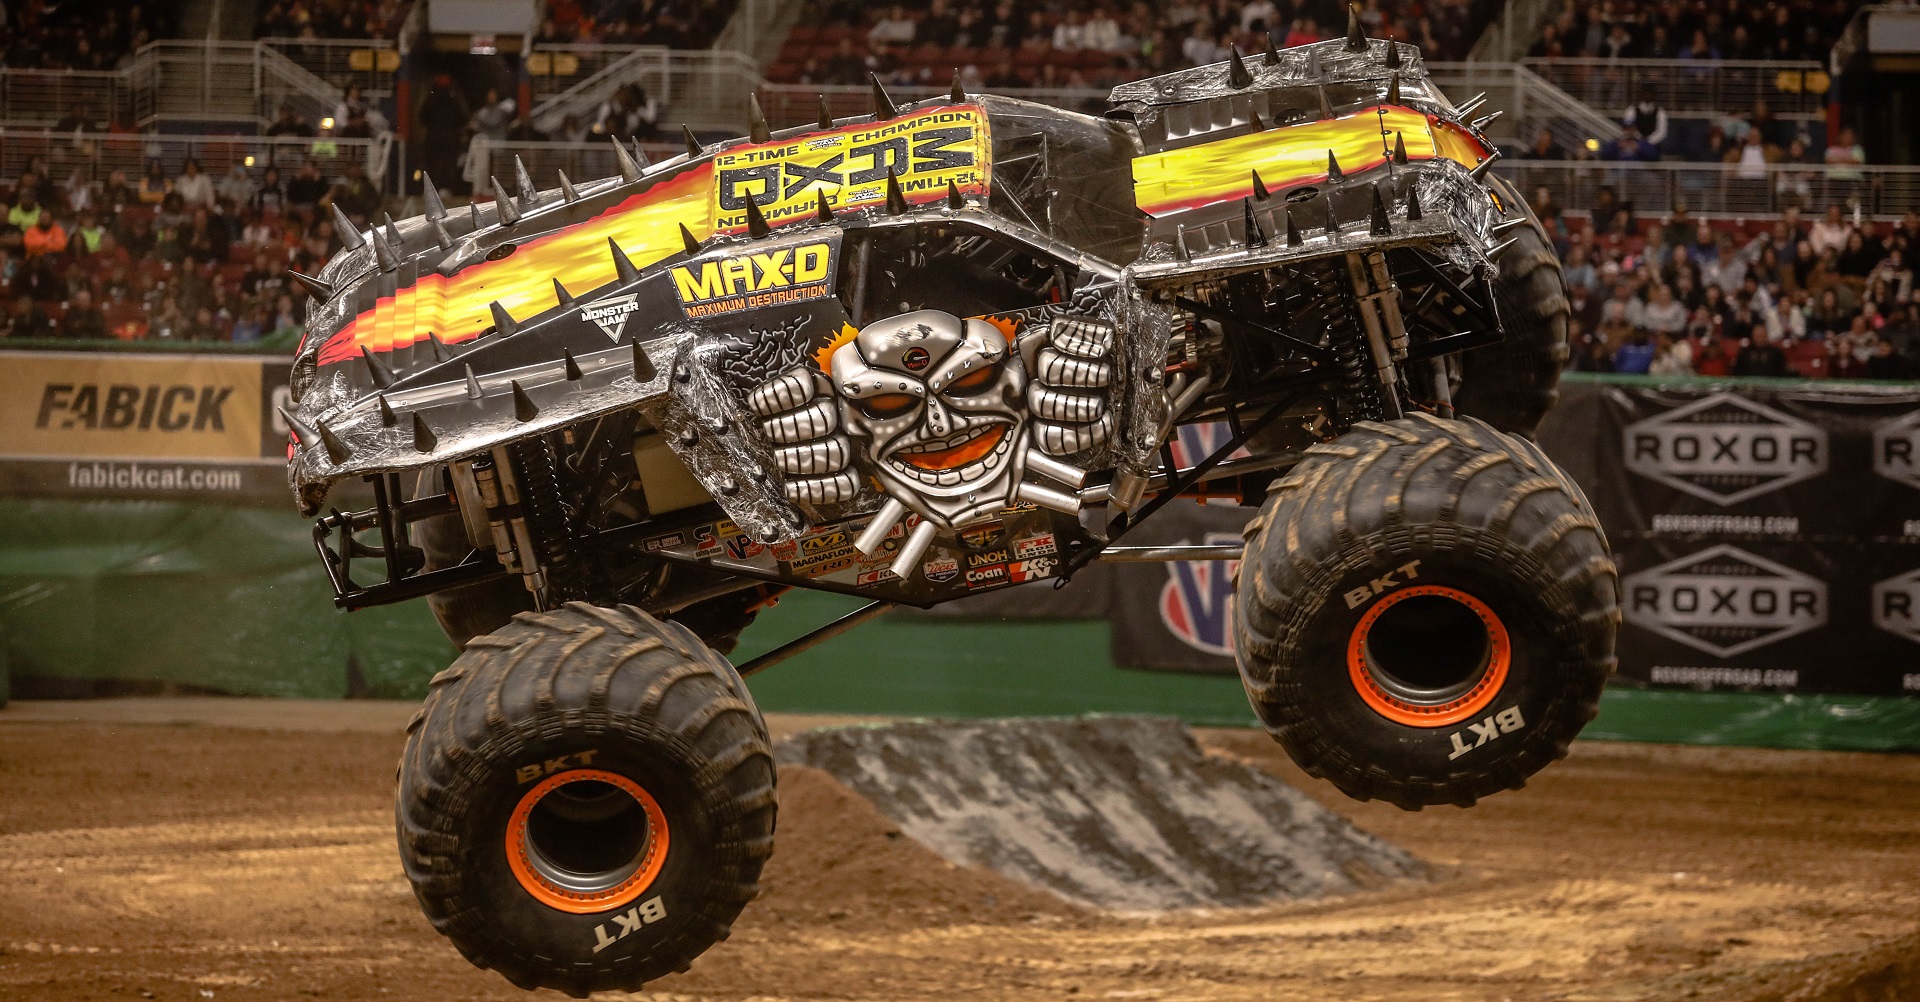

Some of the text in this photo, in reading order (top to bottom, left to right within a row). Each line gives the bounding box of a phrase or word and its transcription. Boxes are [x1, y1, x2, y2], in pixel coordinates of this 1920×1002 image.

[716, 112, 972, 166] 12-TIME CHAMPION
[670, 243, 830, 303] MAX-D
[580, 301, 640, 323] MONSTER
[686, 285, 828, 318] MAXIMUM DESTRUCTION
[599, 313, 626, 327] JAM
[35, 384, 234, 432] FABICK
[1633, 434, 1818, 465] ROXOR
[69, 463, 241, 490] fabickcat.com
[793, 547, 854, 569] MAGNAFLOW
[968, 550, 1008, 566] UNOH
[1018, 548, 1055, 559] ENDS
[1025, 544, 1054, 554] ROD
[965, 567, 1004, 582] Coan
[1020, 558, 1059, 581] K&N
[1343, 559, 1422, 610] BKT
[1632, 585, 1819, 617] ROXOR
[1448, 704, 1526, 762] BKT
[515, 749, 599, 785] BKT
[592, 894, 669, 954] BKT
